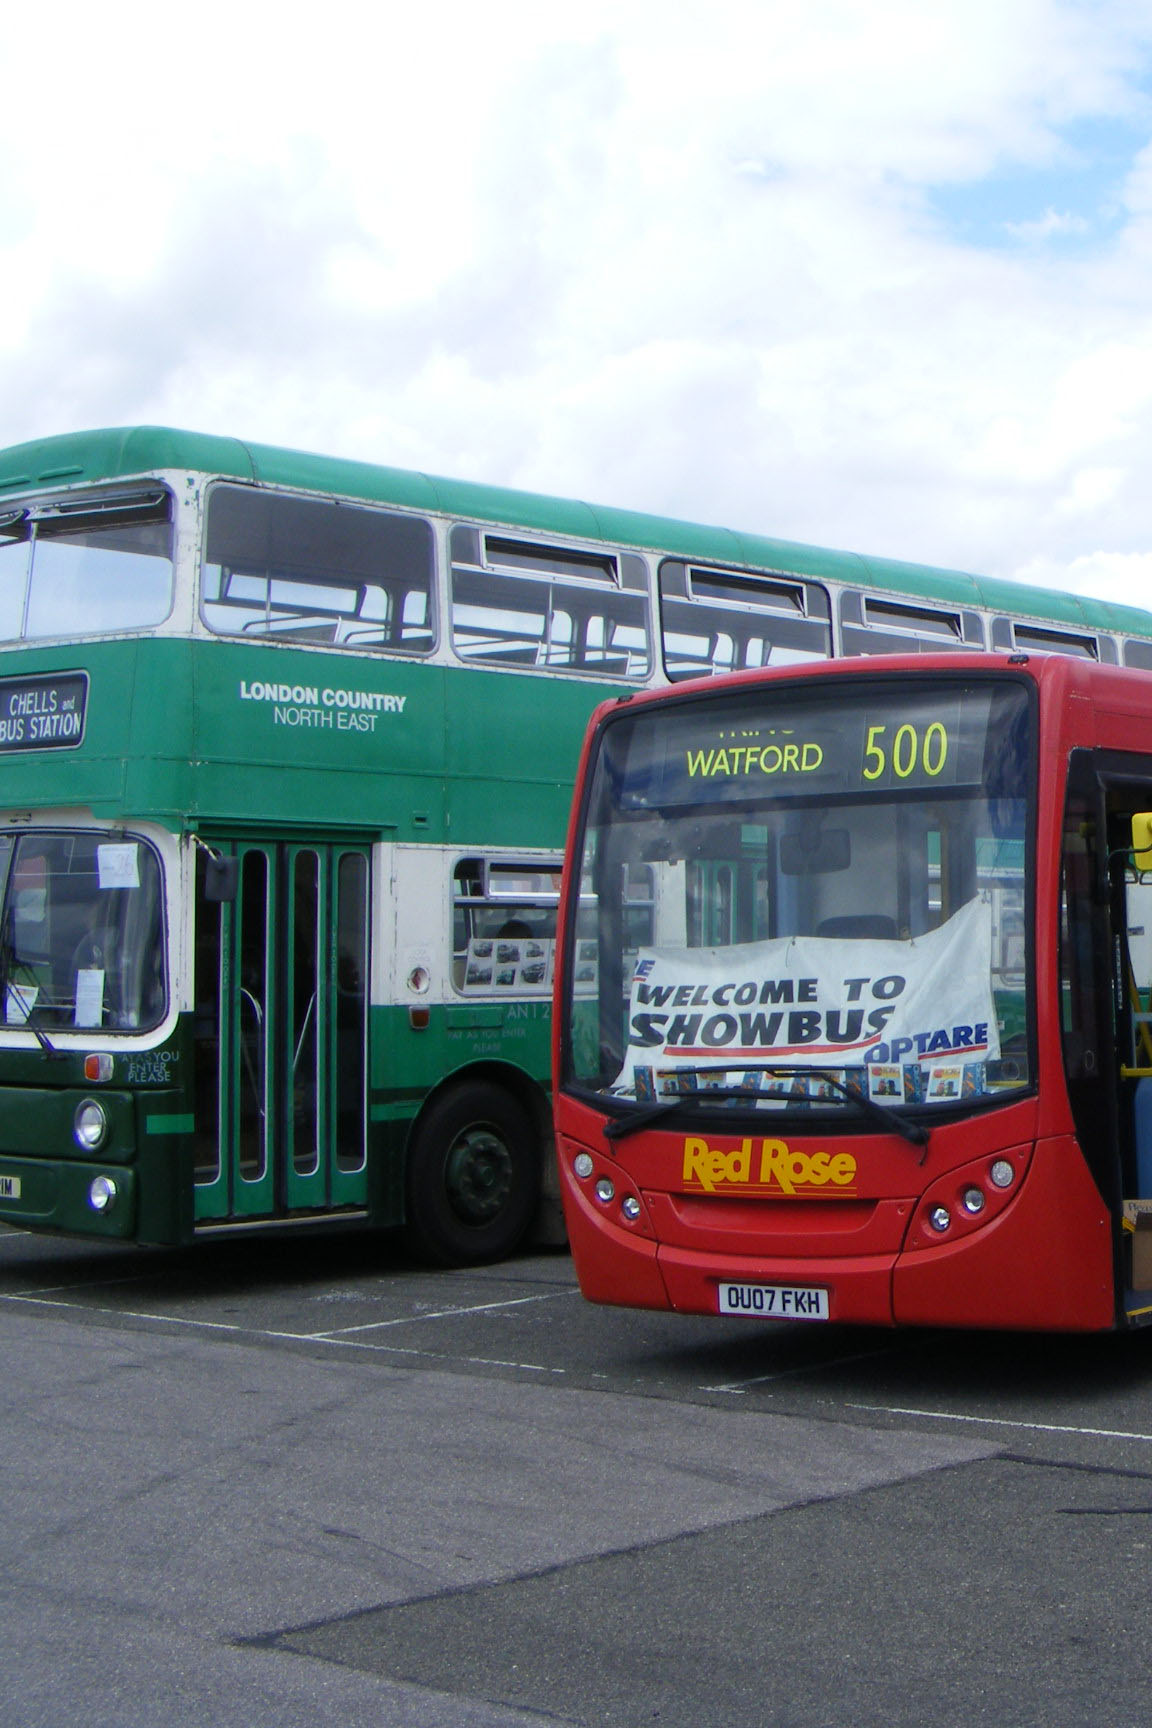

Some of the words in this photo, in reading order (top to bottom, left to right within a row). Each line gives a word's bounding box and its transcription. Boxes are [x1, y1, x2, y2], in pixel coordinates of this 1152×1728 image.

[9, 690, 58, 716] CHELLS
[240, 680, 318, 705] LONDON
[321, 688, 407, 713] COUNTRY
[0, 719, 24, 740] BUS
[30, 712, 82, 739] STATION
[274, 706, 333, 729] NORTH
[337, 712, 379, 732] EAST
[687, 743, 824, 777] WATFORD
[863, 722, 948, 780] 500
[637, 978, 819, 1008] WELCOME
[843, 975, 907, 1002] TO
[628, 1005, 896, 1048] SHOWBUS
[863, 1022, 988, 1064] OPTARE
[129, 1062, 167, 1073] ENTER
[153, 1051, 180, 1064] YOU
[127, 1071, 171, 1083] PLEASE
[682, 1137, 753, 1192] Red
[759, 1138, 857, 1195] Rose
[781, 1289, 820, 1314] FKH
